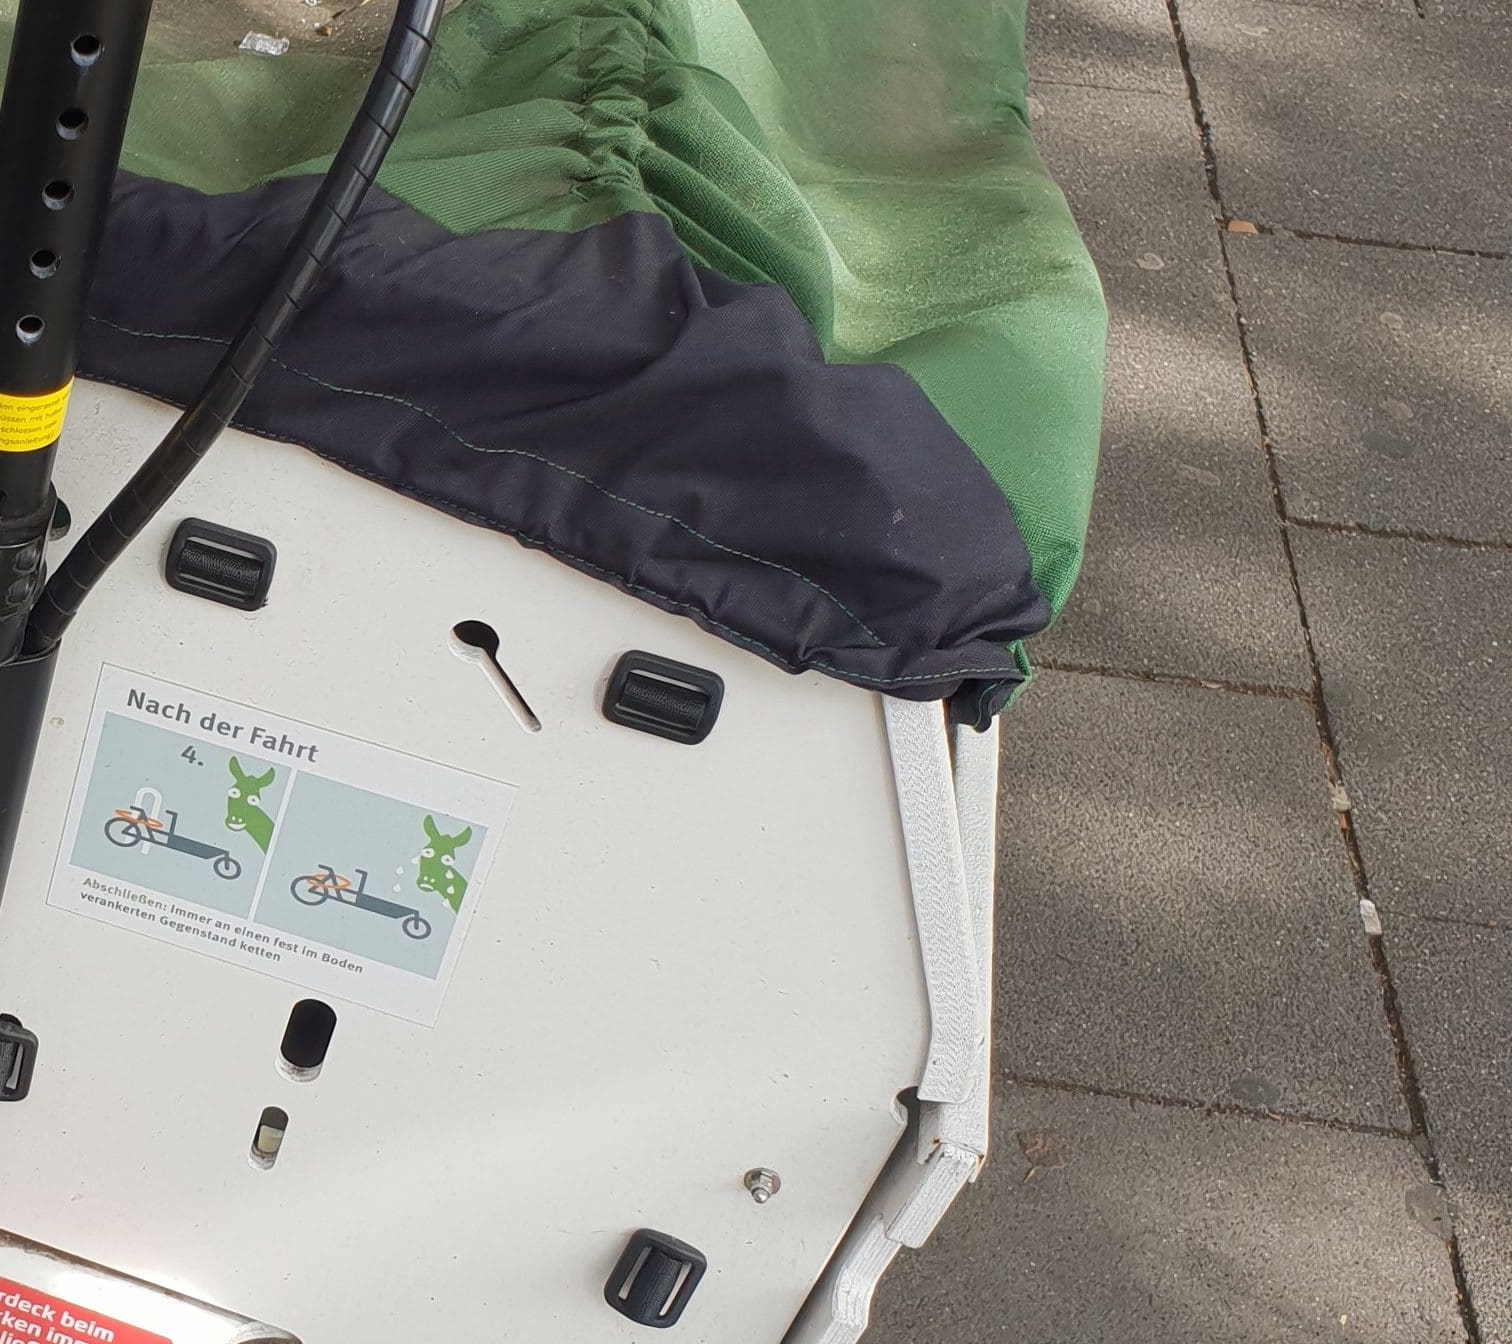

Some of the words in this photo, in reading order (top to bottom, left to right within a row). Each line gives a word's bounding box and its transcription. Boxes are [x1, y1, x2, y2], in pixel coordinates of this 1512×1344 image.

[127, 688, 191, 724] Nach
[199, 712, 244, 739] der
[249, 726, 319, 763] Fahrt
[181, 745, 204, 767] 4.
[80, 891, 156, 923] verankerten
[159, 914, 237, 948] Gegenstand
[240, 940, 282, 962] ketten
[82, 877, 167, 911] Abschließen:
[170, 903, 213, 925] Immer
[214, 918, 231, 932] an
[233, 924, 271, 944] einen
[273, 936, 299, 954] fest
[301, 944, 318, 960] im
[321, 952, 364, 974] Boden
[60, 1310, 115, 1343] beim
